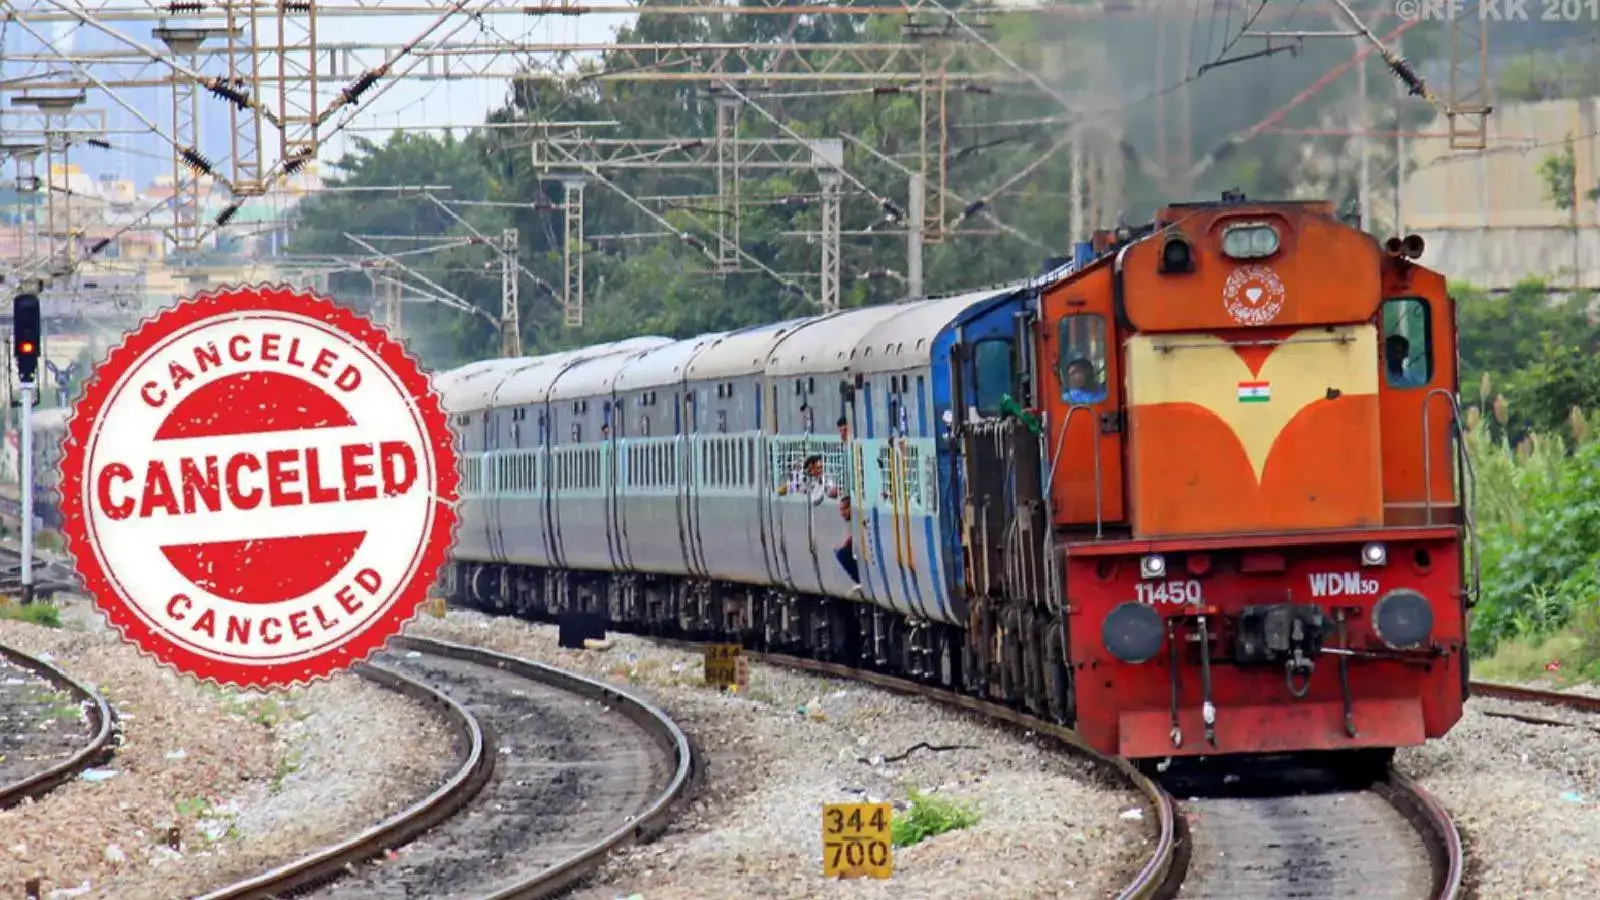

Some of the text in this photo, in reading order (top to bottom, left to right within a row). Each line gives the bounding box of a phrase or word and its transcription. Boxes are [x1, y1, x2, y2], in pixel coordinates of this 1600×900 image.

[1134, 580, 1201, 604] 11450
[827, 808, 887, 833] 344
[825, 841, 887, 868] 700
